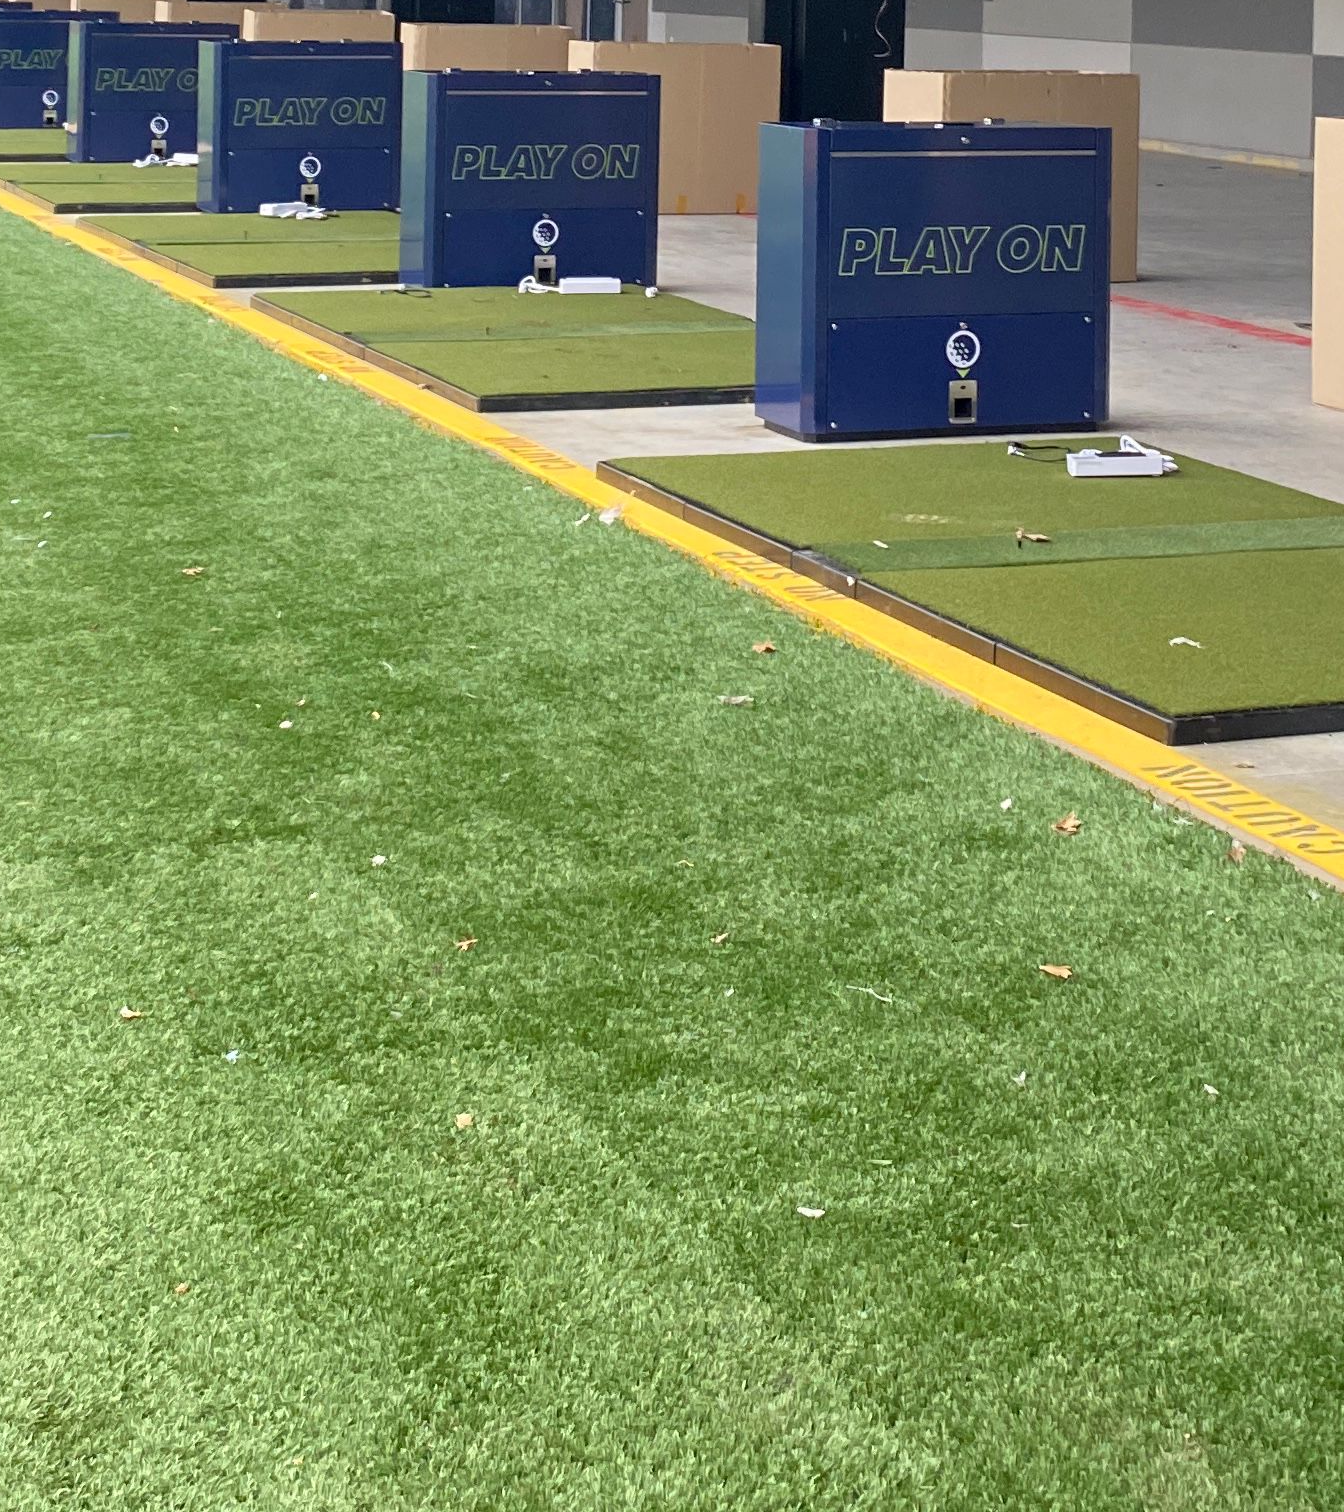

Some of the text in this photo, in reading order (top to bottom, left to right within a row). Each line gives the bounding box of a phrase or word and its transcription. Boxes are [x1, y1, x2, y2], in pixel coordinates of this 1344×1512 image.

[95, 68, 198, 92] PLAY O
[233, 96, 386, 126] PLAY ON
[452, 143, 639, 180] PLAY ON
[838, 224, 1086, 276] PLAY ON
